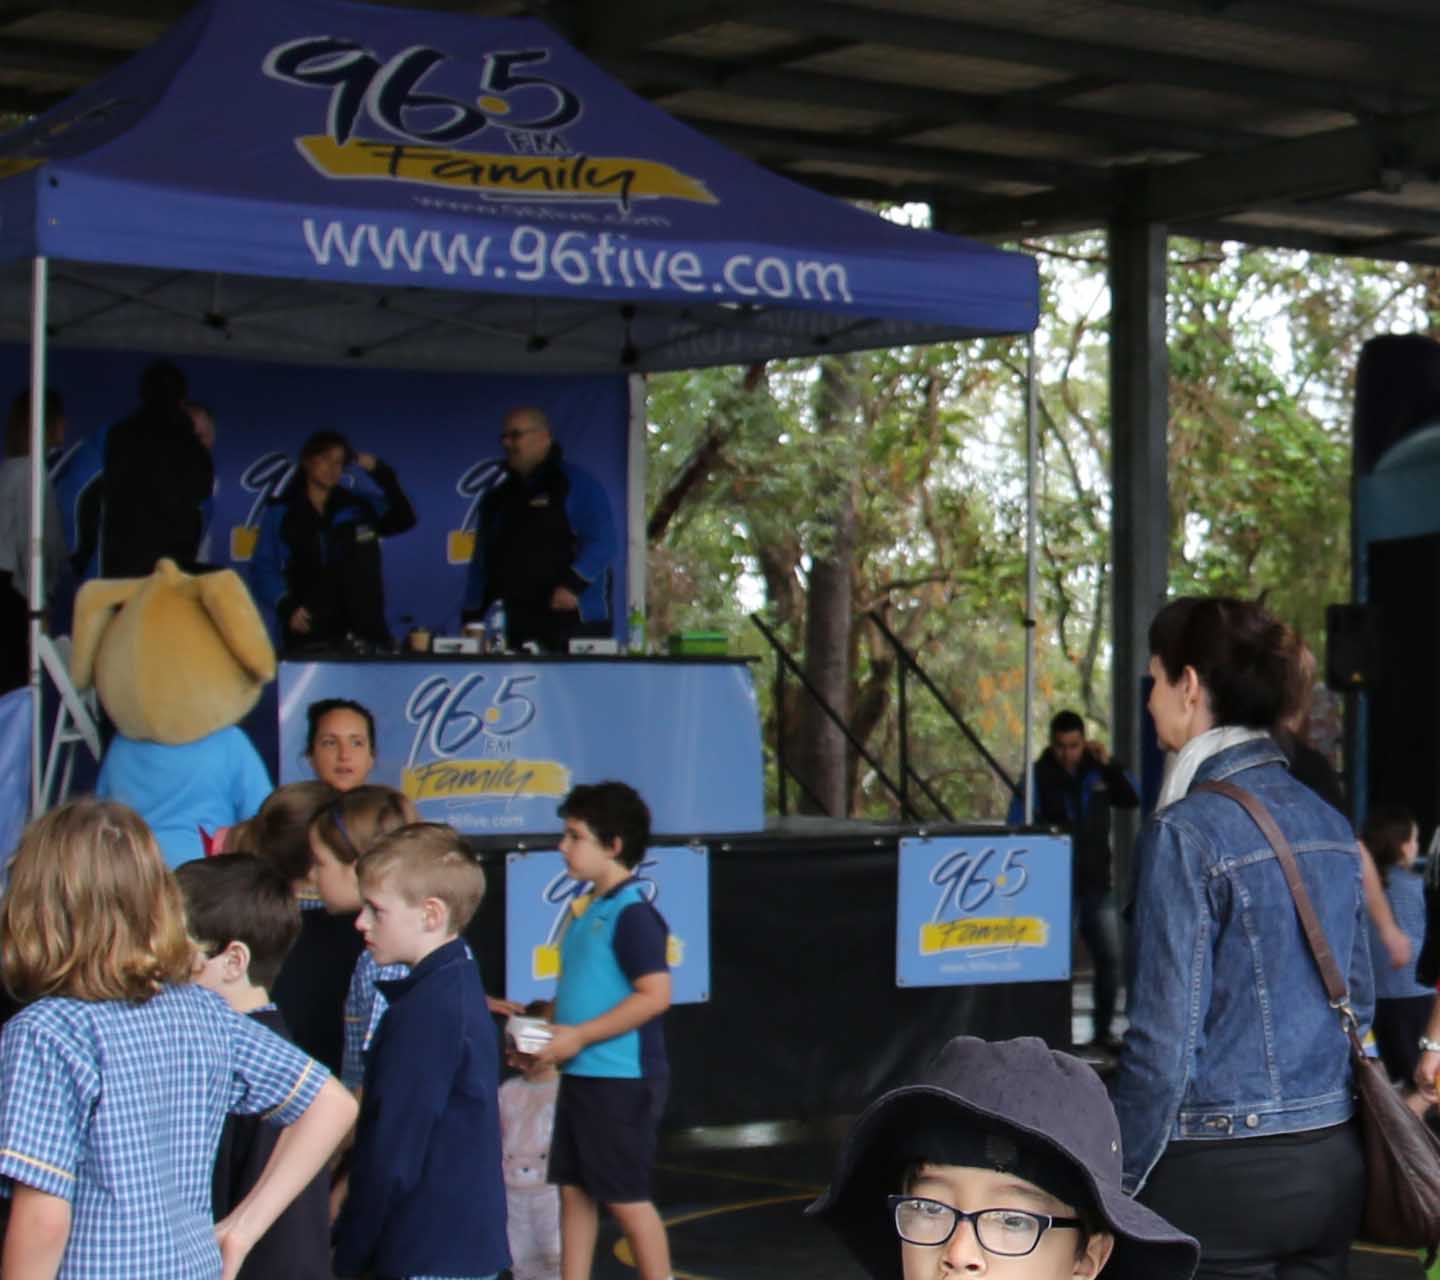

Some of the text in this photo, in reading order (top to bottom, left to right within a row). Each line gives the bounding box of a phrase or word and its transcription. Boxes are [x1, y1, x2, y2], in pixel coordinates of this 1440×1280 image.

[357, 141, 640, 214] Family
[302, 218, 855, 304] www.96five.com
[417, 759, 535, 800] Family
